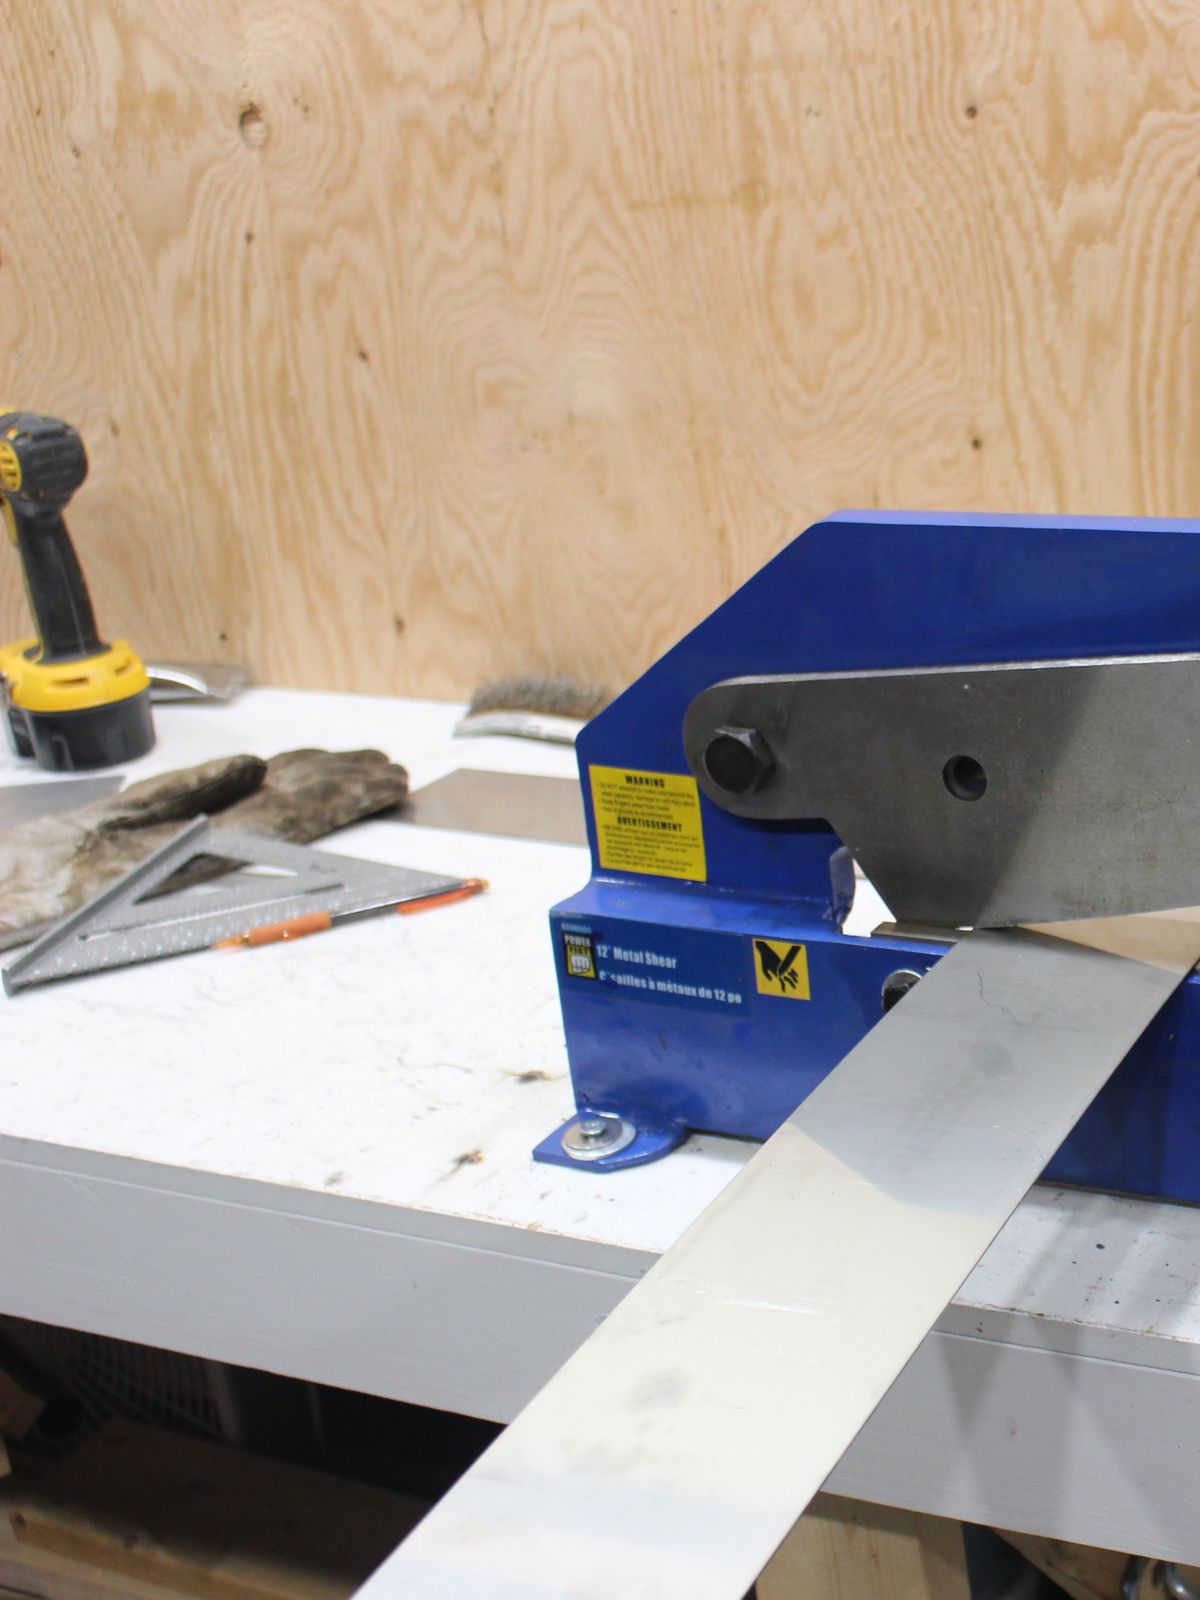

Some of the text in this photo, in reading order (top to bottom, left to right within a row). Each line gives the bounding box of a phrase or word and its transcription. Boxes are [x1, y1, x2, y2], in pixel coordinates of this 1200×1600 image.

[625, 775, 665, 789] WARNING
[617, 816, 682, 832] AVERTISSEMENT
[564, 935, 592, 947] POWER
[613, 947, 644, 964] Metal
[644, 952, 678, 969] Shear
[648, 977, 656, 990] à
[656, 980, 697, 997] métaux
[698, 986, 712, 999] de
[713, 989, 726, 1002] 12
[727, 992, 742, 1005] po
